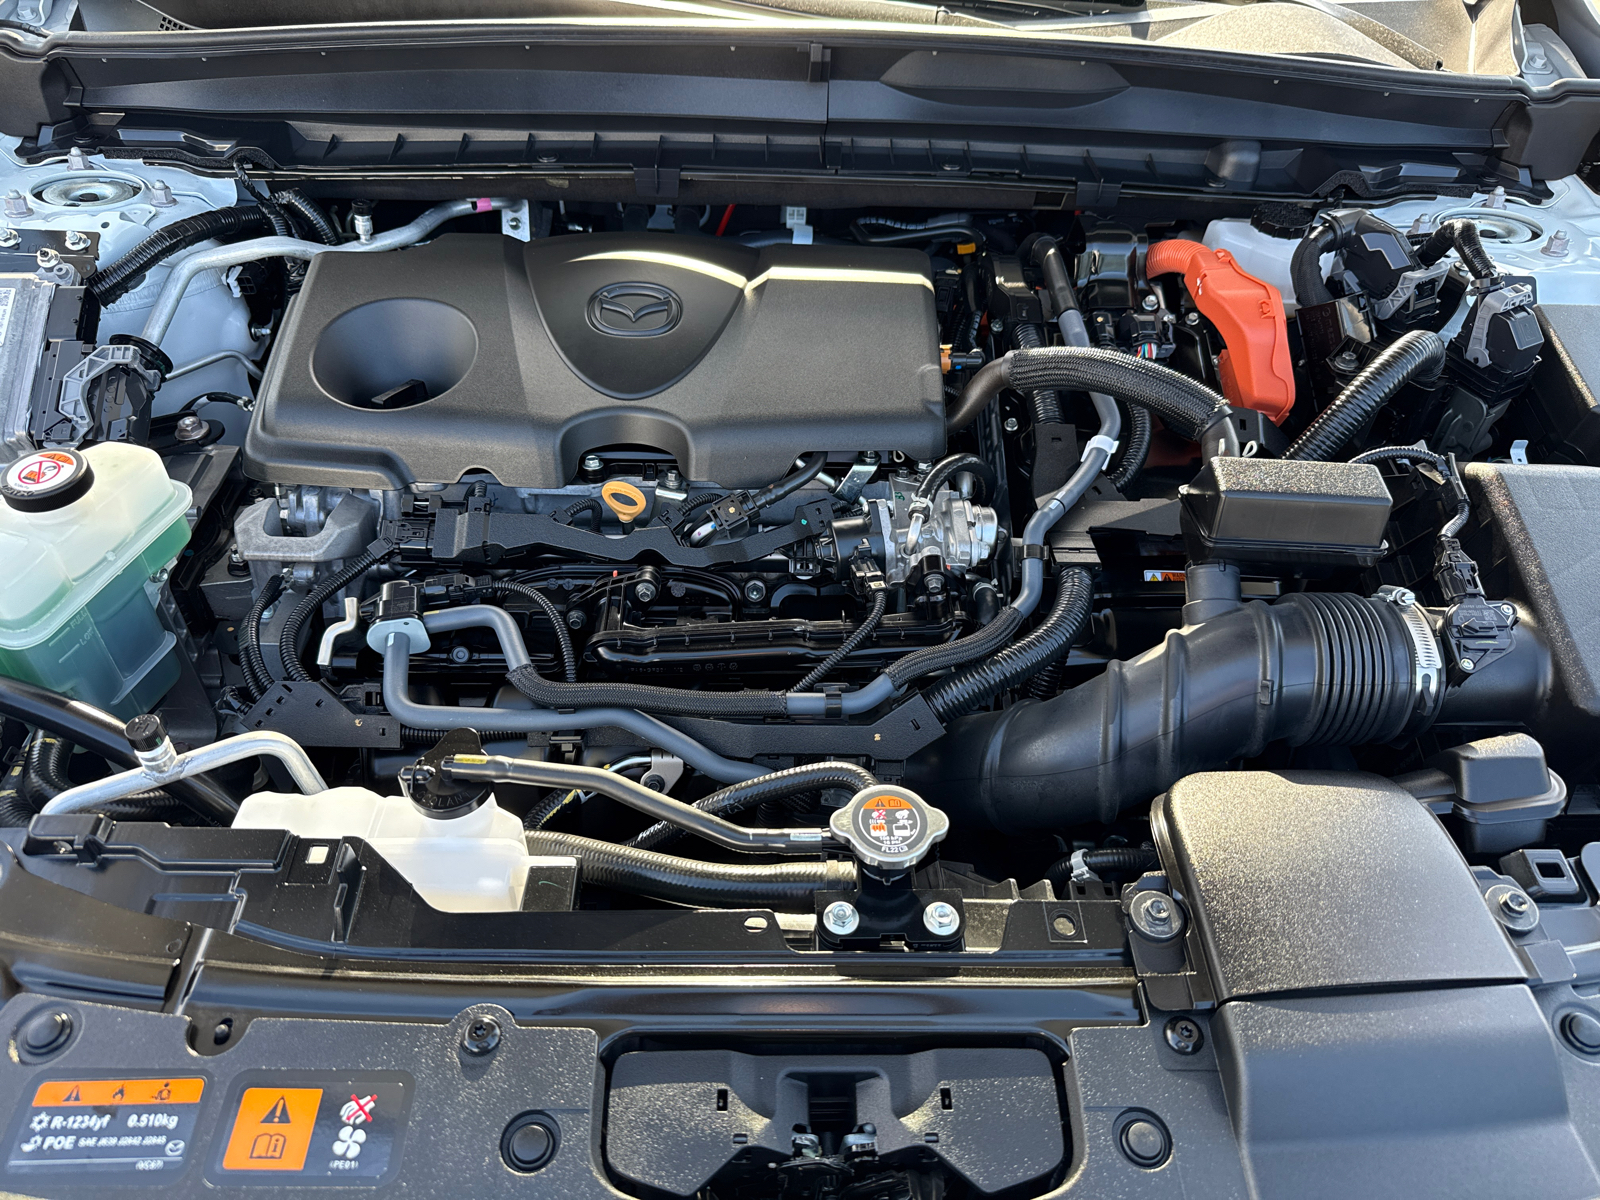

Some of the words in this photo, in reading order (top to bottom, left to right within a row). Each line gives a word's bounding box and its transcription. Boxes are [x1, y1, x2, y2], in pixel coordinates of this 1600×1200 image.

[416, 790, 472, 808] COOLANT
[50, 1114, 111, 1131] R-1234yf
[126, 1114, 179, 1130] 0.510kg
[42, 1135, 76, 1150] POE
[78, 1137, 98, 1147] SAE
[329, 1160, 359, 1170] (PE01)
